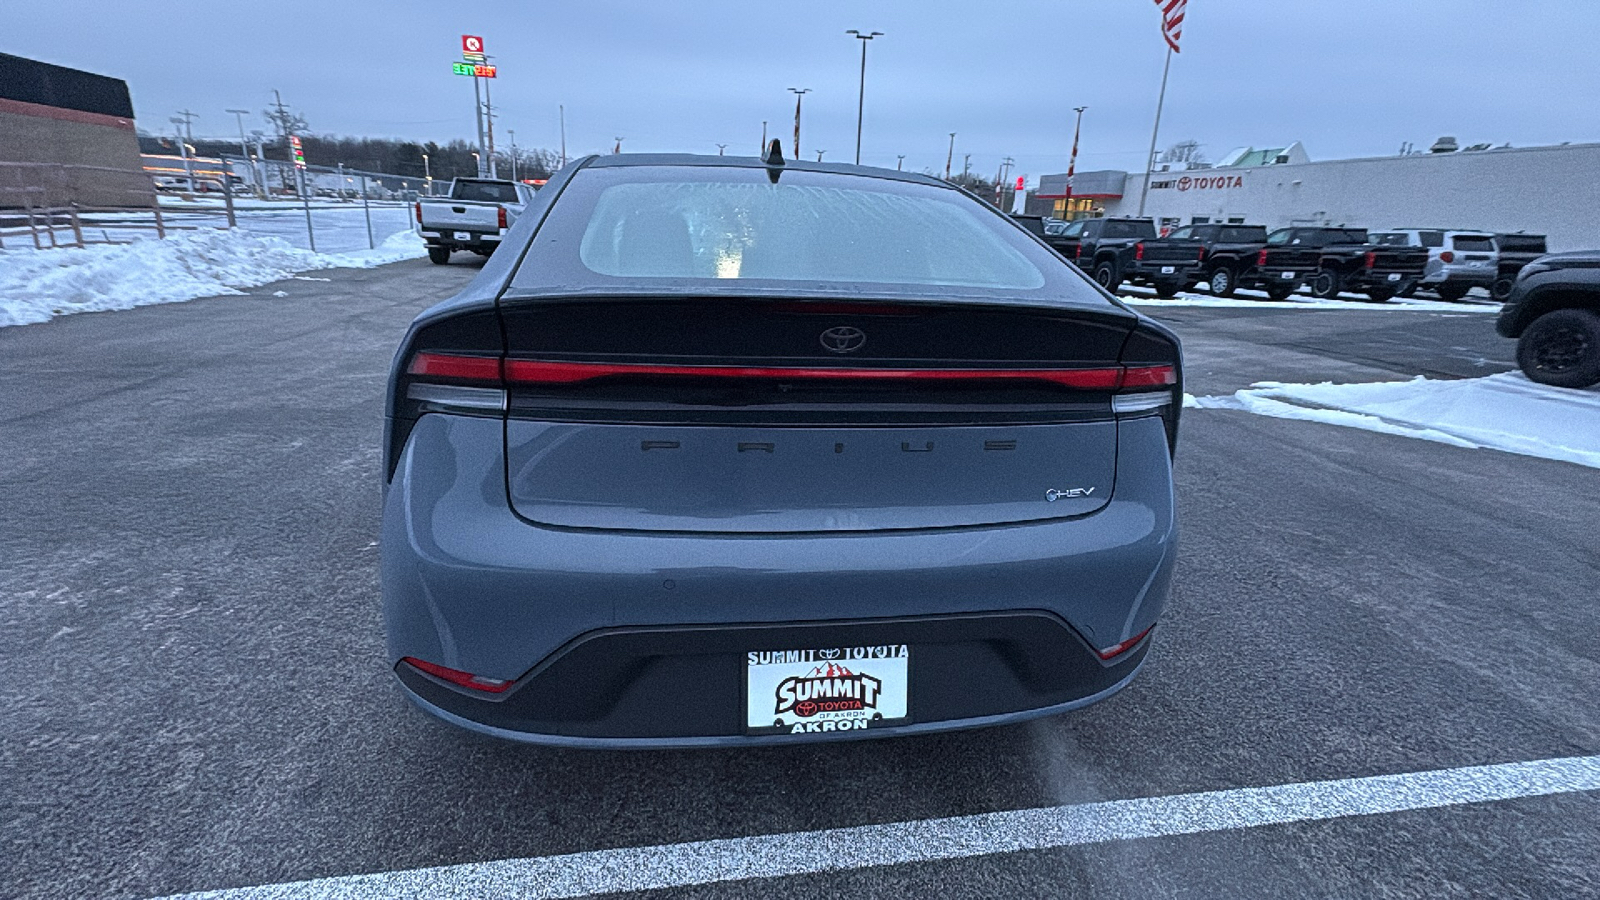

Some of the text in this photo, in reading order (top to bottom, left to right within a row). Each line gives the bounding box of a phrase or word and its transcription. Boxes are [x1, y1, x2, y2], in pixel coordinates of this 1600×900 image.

[1193, 176, 1243, 189] TOYOTA
[747, 645, 909, 666] SUMMIT TOYOTA
[777, 673, 880, 713] SUMMIT
[818, 700, 863, 711] TOYOTA
[791, 719, 868, 734] AKRON
